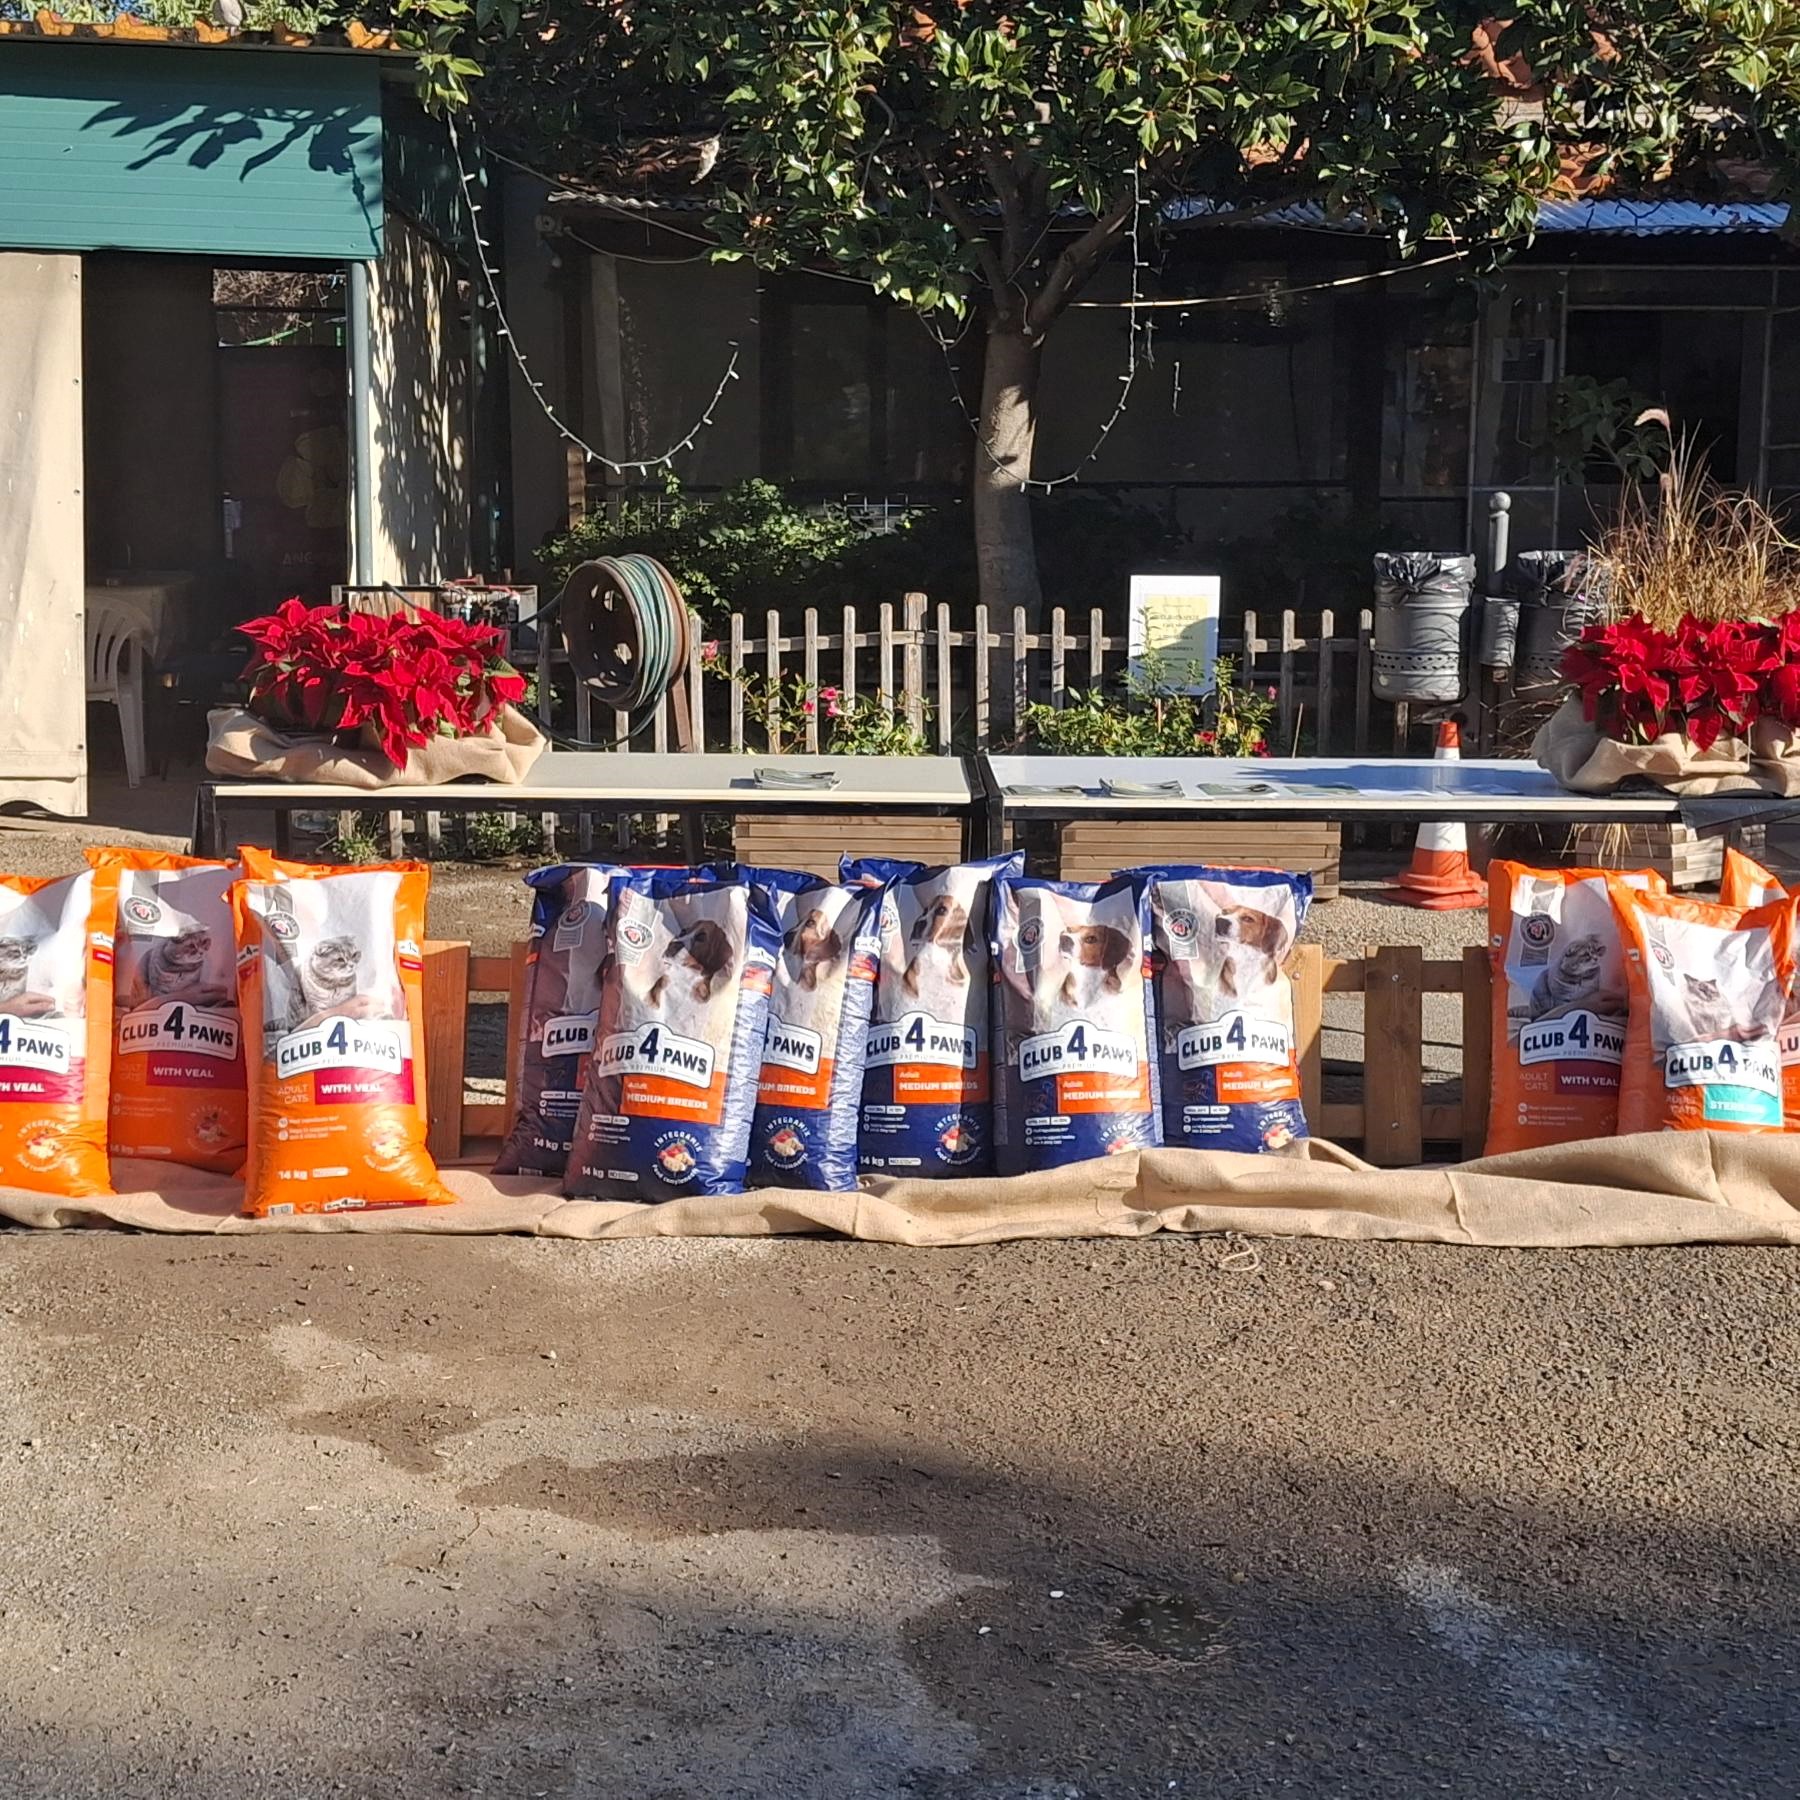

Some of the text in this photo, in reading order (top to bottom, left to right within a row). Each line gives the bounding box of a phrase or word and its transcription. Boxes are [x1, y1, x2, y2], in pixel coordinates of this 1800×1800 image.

[122, 1006, 234, 1047] CLUB 4 PAWS
[1524, 1014, 1625, 1053] CLUB 4 PAW
[281, 1021, 396, 1065] CLUB 4 PAWS
[547, 1027, 588, 1046] CLUB
[866, 1017, 973, 1058] CLUB 4 PAWS
[1182, 1015, 1286, 1060] CLUB 4 PAWS
[17, 1037, 64, 1059] PAWS
[603, 1028, 708, 1075] CLUB 4 PAWS
[773, 1036, 815, 1061] PAWS
[1023, 1045, 1062, 1070] CLUB
[1066, 1025, 1088, 1061] 4
[1669, 1056, 1713, 1076] CLUB
[1718, 1044, 1738, 1074] 4
[153, 1066, 182, 1076] WITH
[185, 1068, 214, 1078] VEAL
[13, 1082, 46, 1093] VEAL
[321, 1084, 352, 1094] WITH
[777, 1083, 816, 1095] BREEDS
[899, 1081, 940, 1091] MEDIUM
[1561, 1075, 1619, 1087] WITH VEAL
[626, 1093, 666, 1105] MEDIUM
[1063, 1091, 1105, 1101] MEDIUM
[533, 1137, 558, 1151] 14 kg
[872, 1155, 885, 1167] kg
[582, 1166, 591, 1176] 14
[593, 1167, 605, 1179] kg
